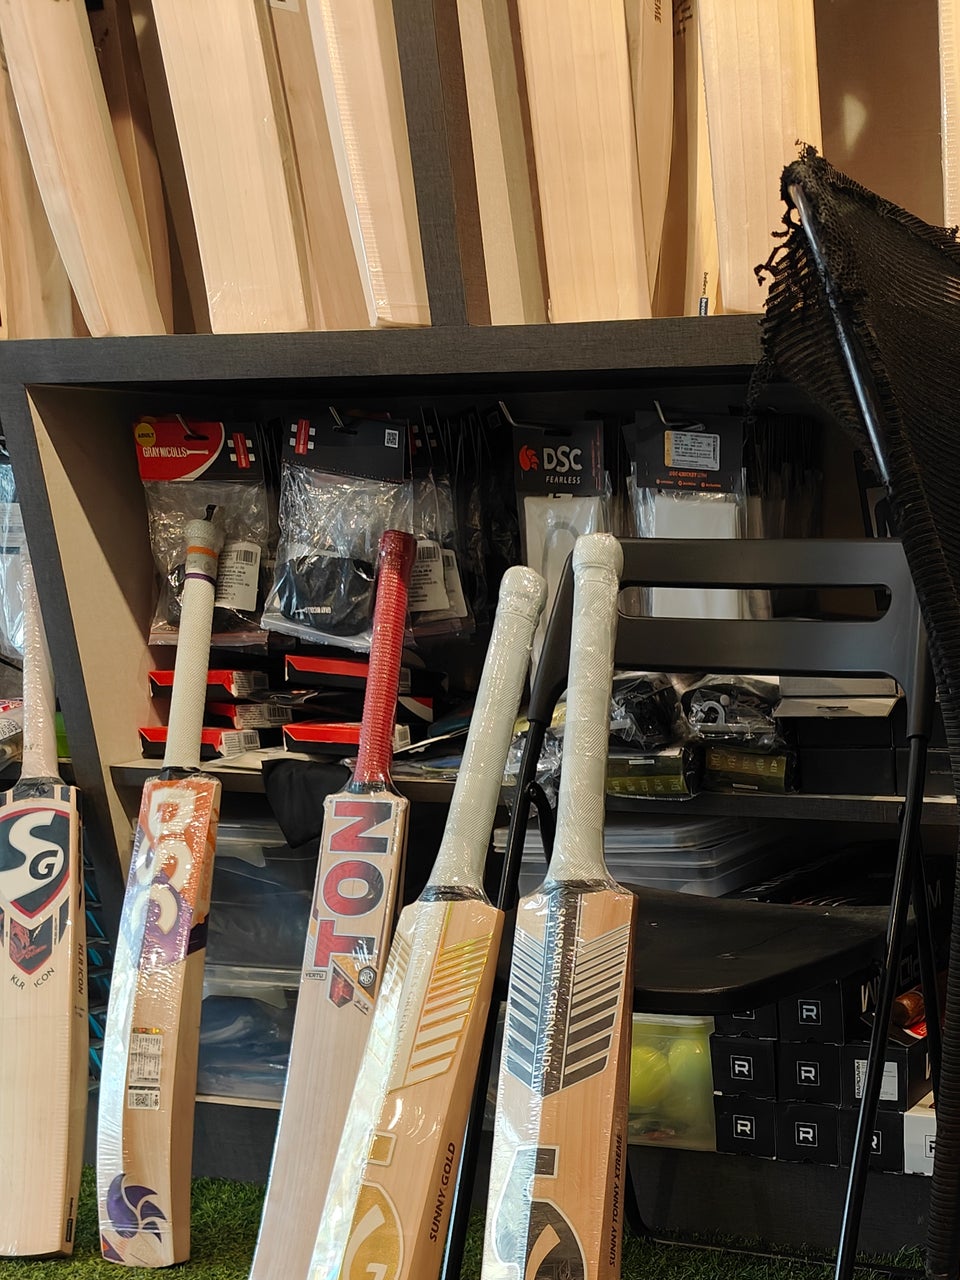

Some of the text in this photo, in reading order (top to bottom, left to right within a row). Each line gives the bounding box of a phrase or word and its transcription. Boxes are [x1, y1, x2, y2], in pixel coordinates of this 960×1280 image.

[543, 445, 583, 473] DSC
[545, 475, 581, 485] FEARLESS
[313, 800, 394, 968] TON
[10, 967, 56, 990] KLR ICON
[540, 907, 567, 1074] SANSPAREILS GREENLANDS
[734, 1060, 749, 1075] R
[800, 1066, 816, 1081] R
[737, 1119, 751, 1135] R
[799, 1127, 814, 1142] R
[429, 1141, 457, 1243] SUNNY GOLD
[609, 1133, 624, 1267] SUNNY TONNY XTREME
